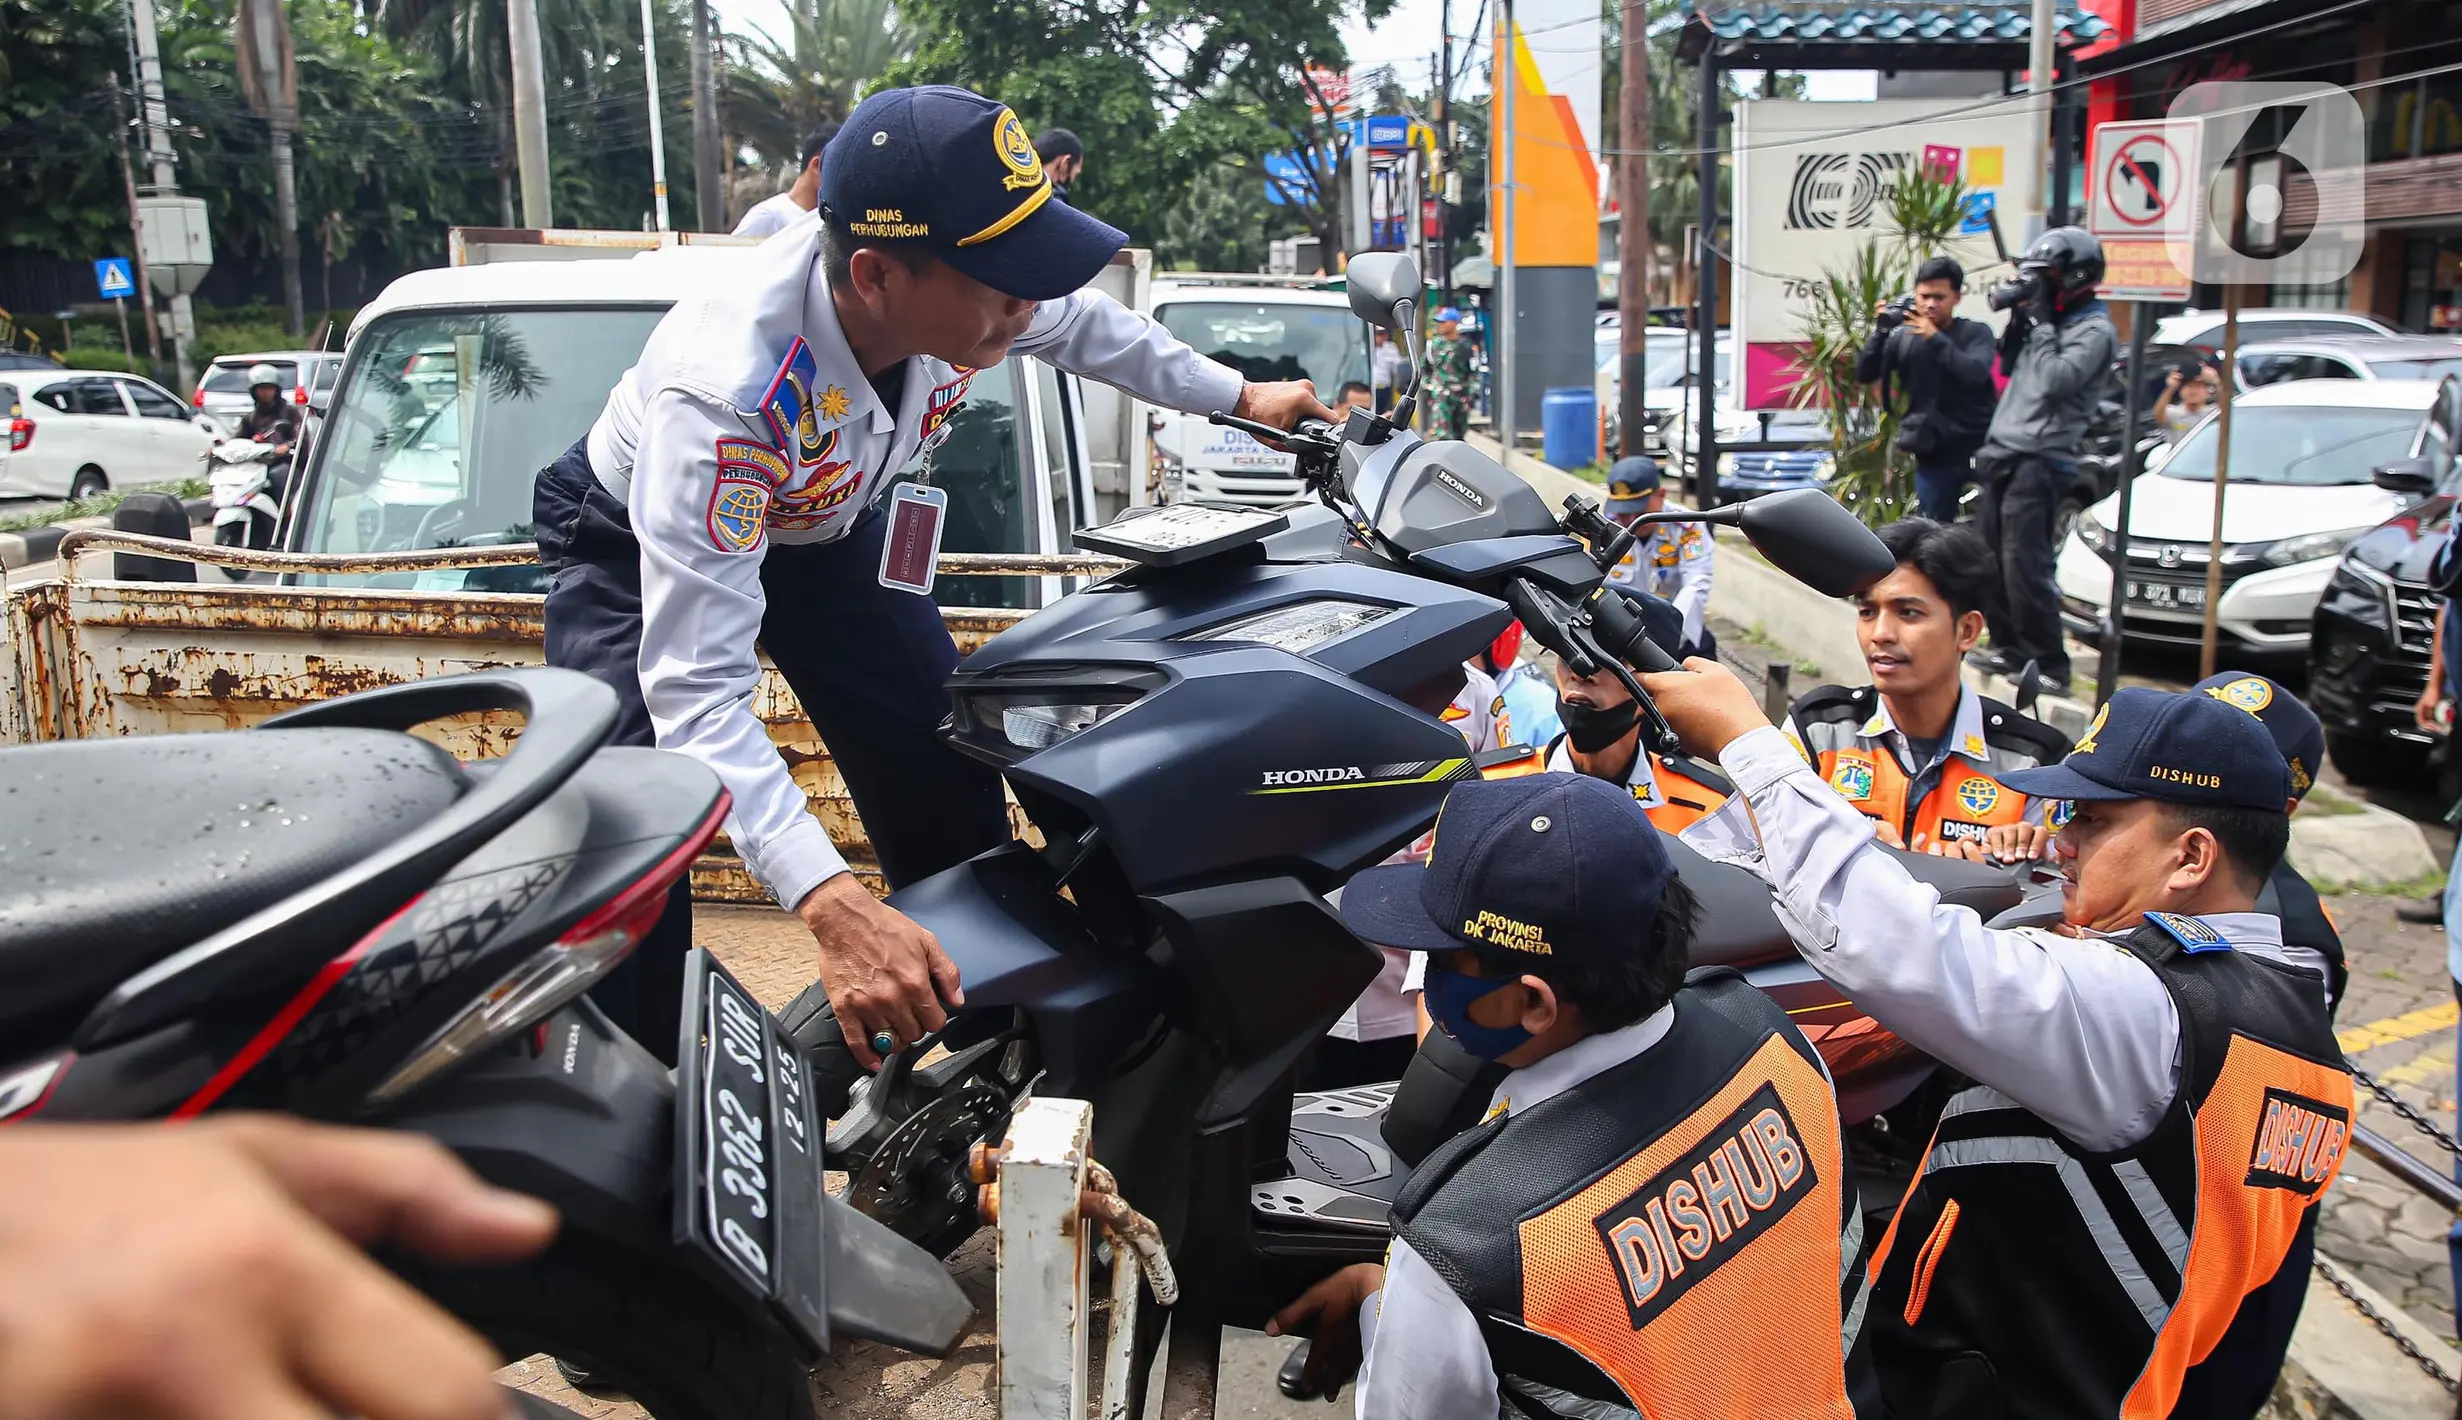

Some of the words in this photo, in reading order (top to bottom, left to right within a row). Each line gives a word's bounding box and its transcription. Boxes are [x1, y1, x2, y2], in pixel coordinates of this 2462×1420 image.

[850, 222, 929, 238] PERHUBUNGAN
[866, 208, 903, 222] DINAS
[1438, 470, 1483, 507] HONDA
[1262, 766, 1366, 785] HONDA
[2150, 765, 2221, 789] DISHUB
[1943, 821, 1986, 842] DISH
[1477, 909, 1543, 942] PROVINSI
[1487, 928, 1553, 955] JAKARTA
[721, 992, 765, 1084] SUR
[717, 1088, 769, 1219] 3362
[2253, 1098, 2346, 1183] DISHUB
[1607, 1108, 1804, 1309] DISHUB
[722, 1217, 769, 1275] B
